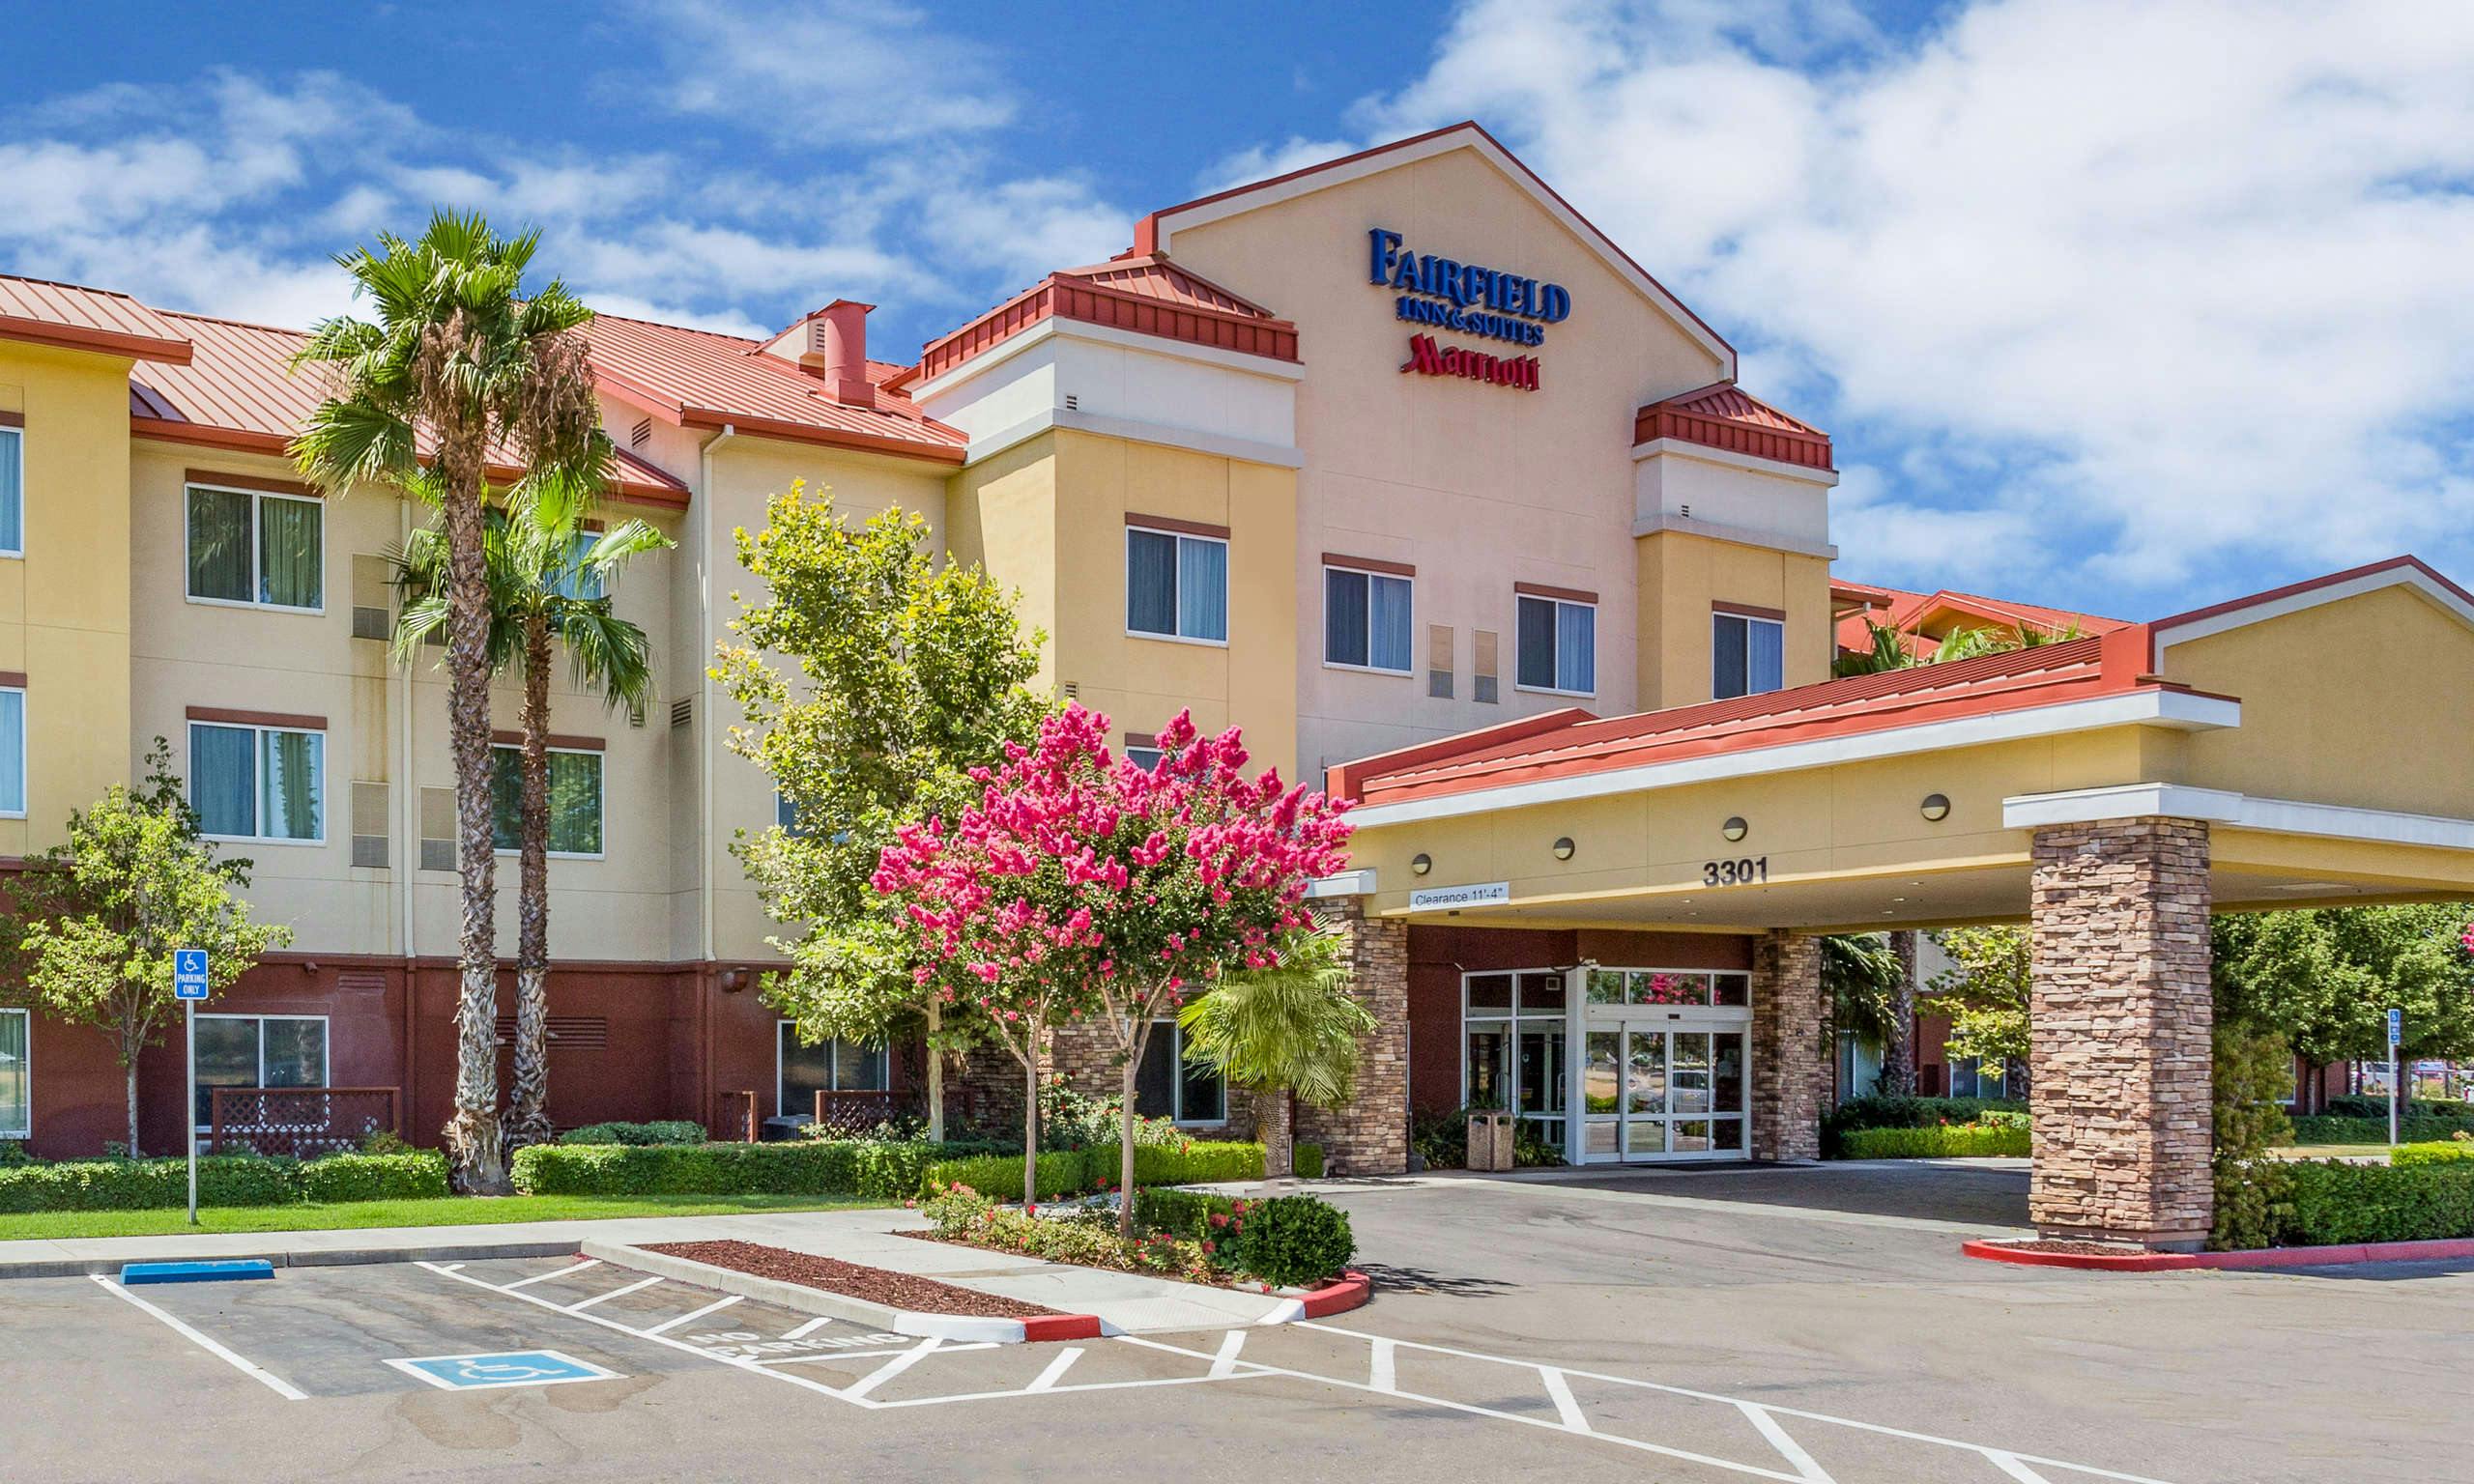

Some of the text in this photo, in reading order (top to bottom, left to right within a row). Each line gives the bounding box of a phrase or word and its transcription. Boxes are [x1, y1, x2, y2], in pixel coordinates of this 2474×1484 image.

[1368, 228, 1570, 324] FAIRFIELD
[1396, 297, 1544, 346] INN & SUITES
[1400, 332, 1540, 391] Marriott
[1703, 856, 1768, 887] 3301
[1415, 893, 1468, 906] Clearance
[178, 974, 206, 984] PARKING
[183, 985, 200, 995] ONLY
[686, 1332, 761, 1343] NO
